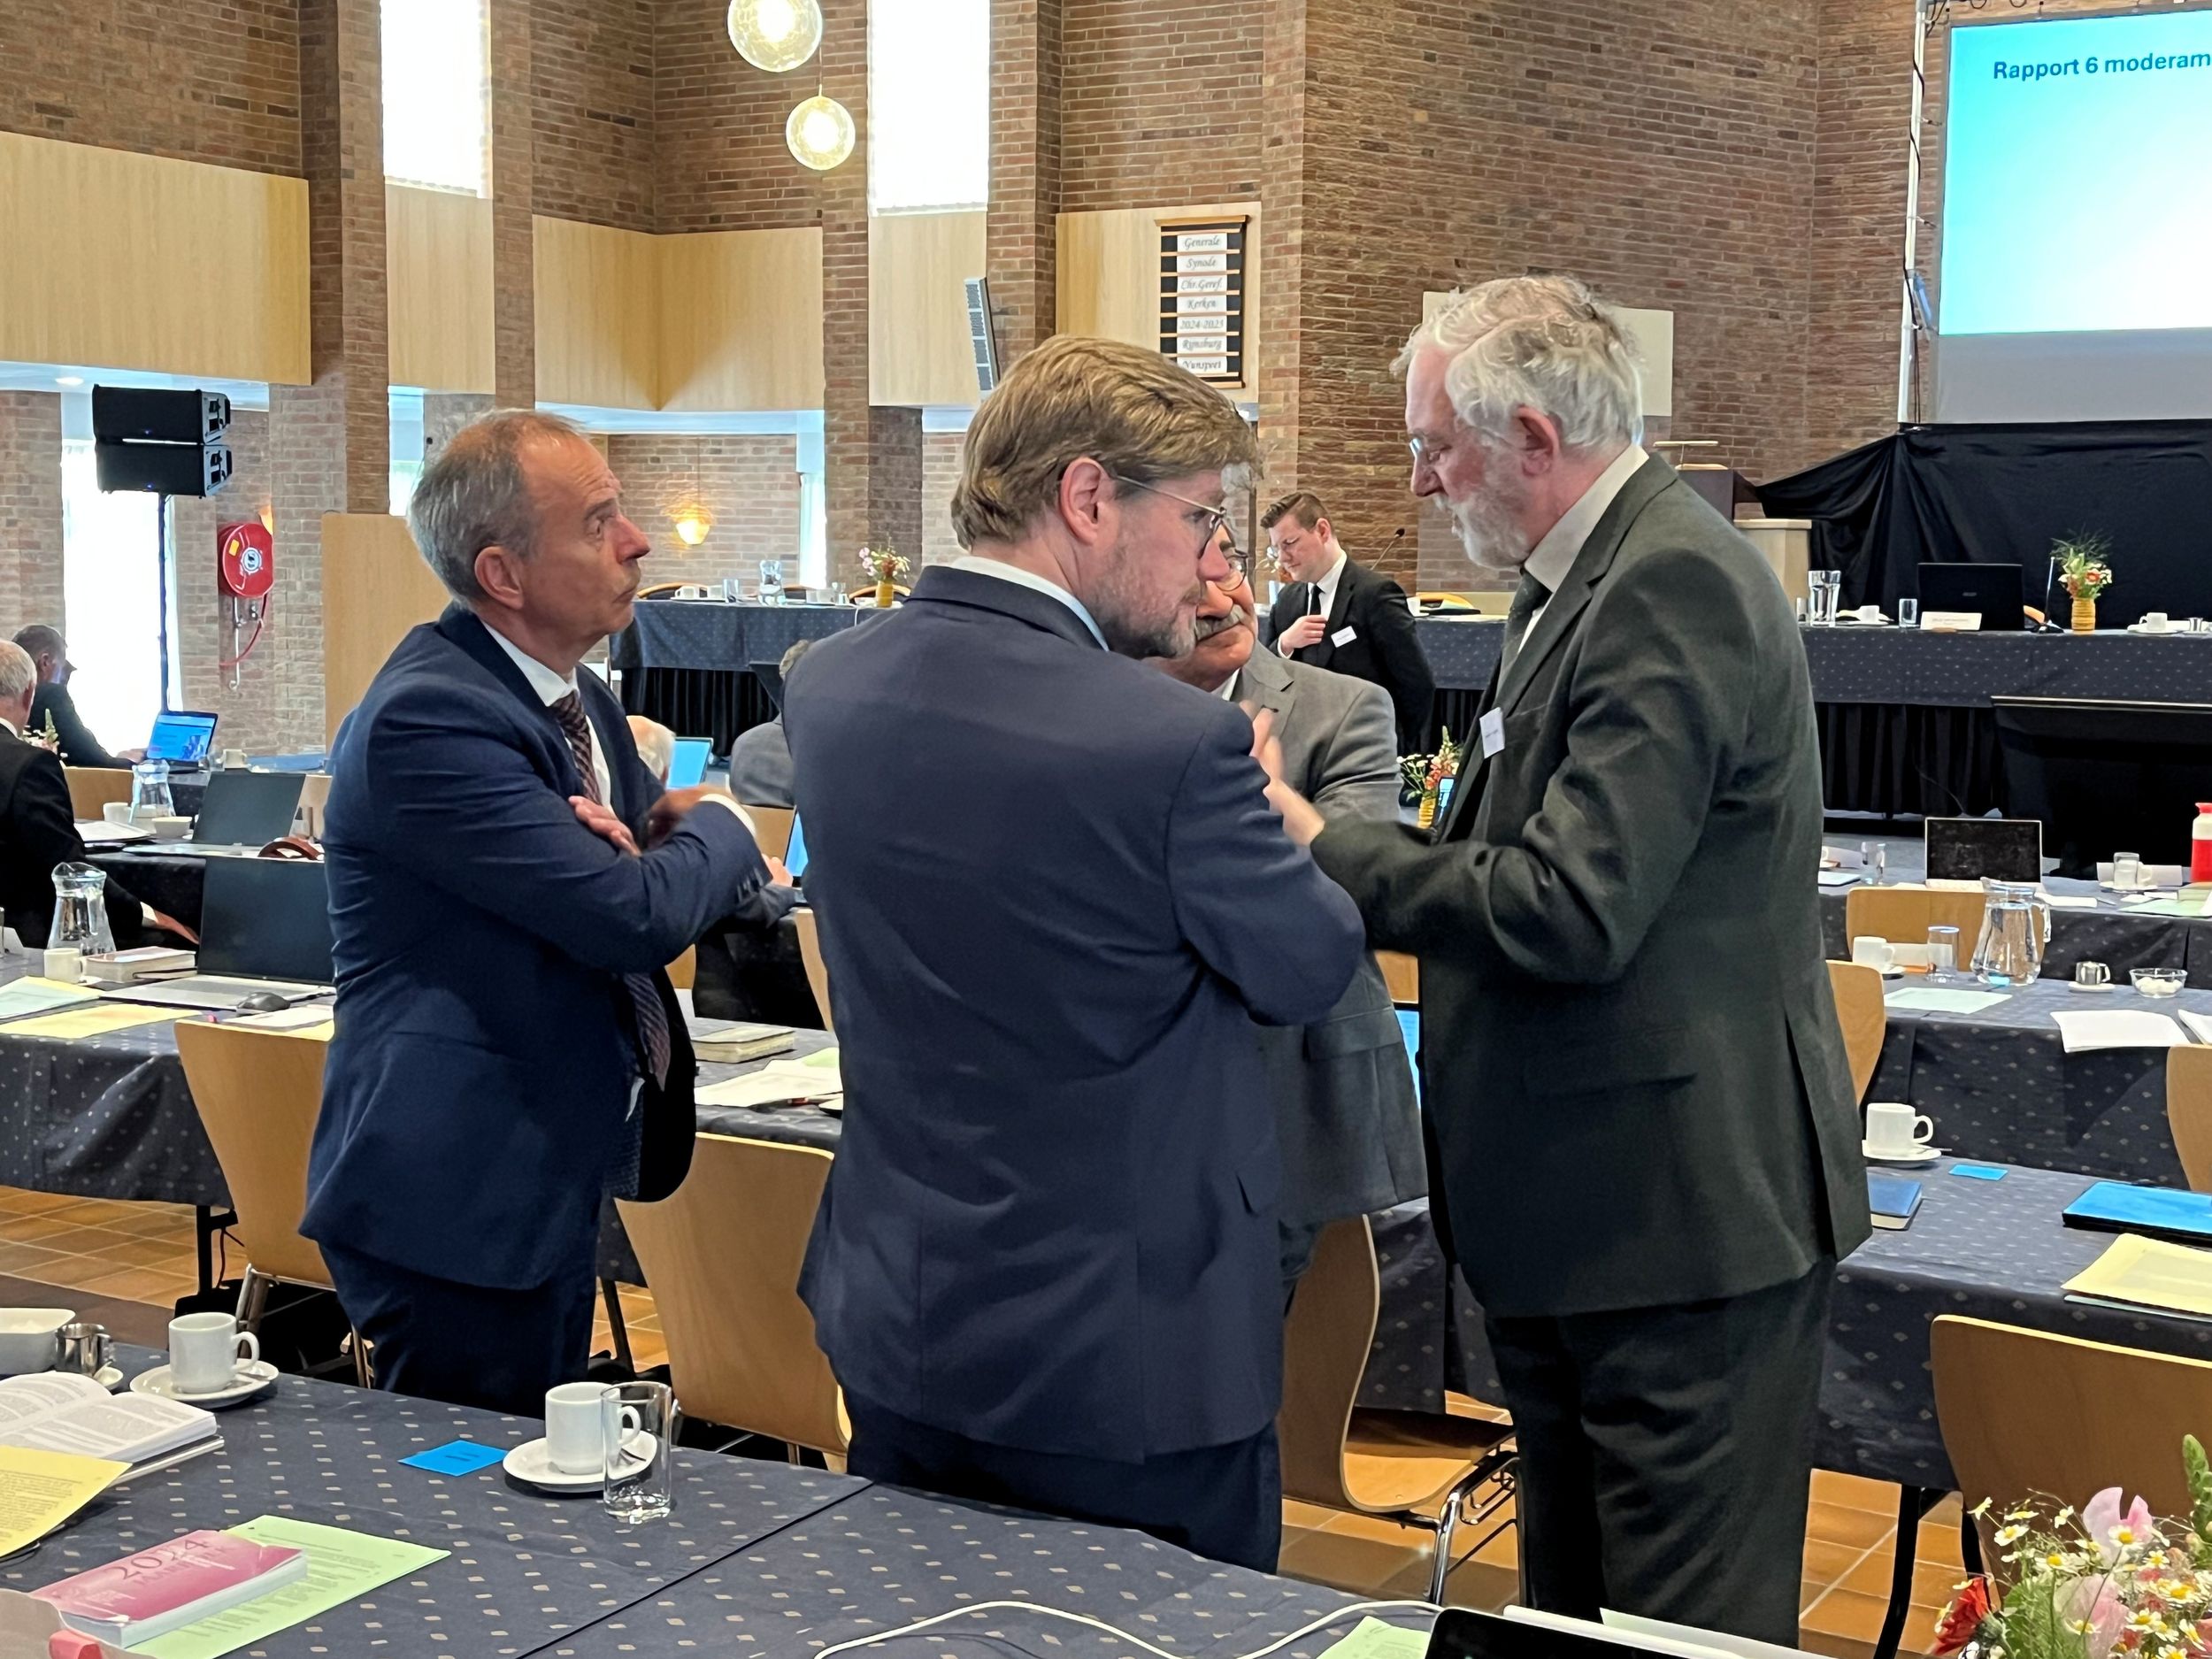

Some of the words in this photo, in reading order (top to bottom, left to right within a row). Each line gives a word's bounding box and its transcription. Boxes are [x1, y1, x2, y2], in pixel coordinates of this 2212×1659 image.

[1993, 58, 2079, 81] Rapport
[2085, 57, 2099, 74] 6
[2105, 52, 2210, 73] moderam
[1184, 234, 1220, 250] Generale
[1186, 256, 1217, 271] Synode
[103, 1539, 210, 1581] 2024
